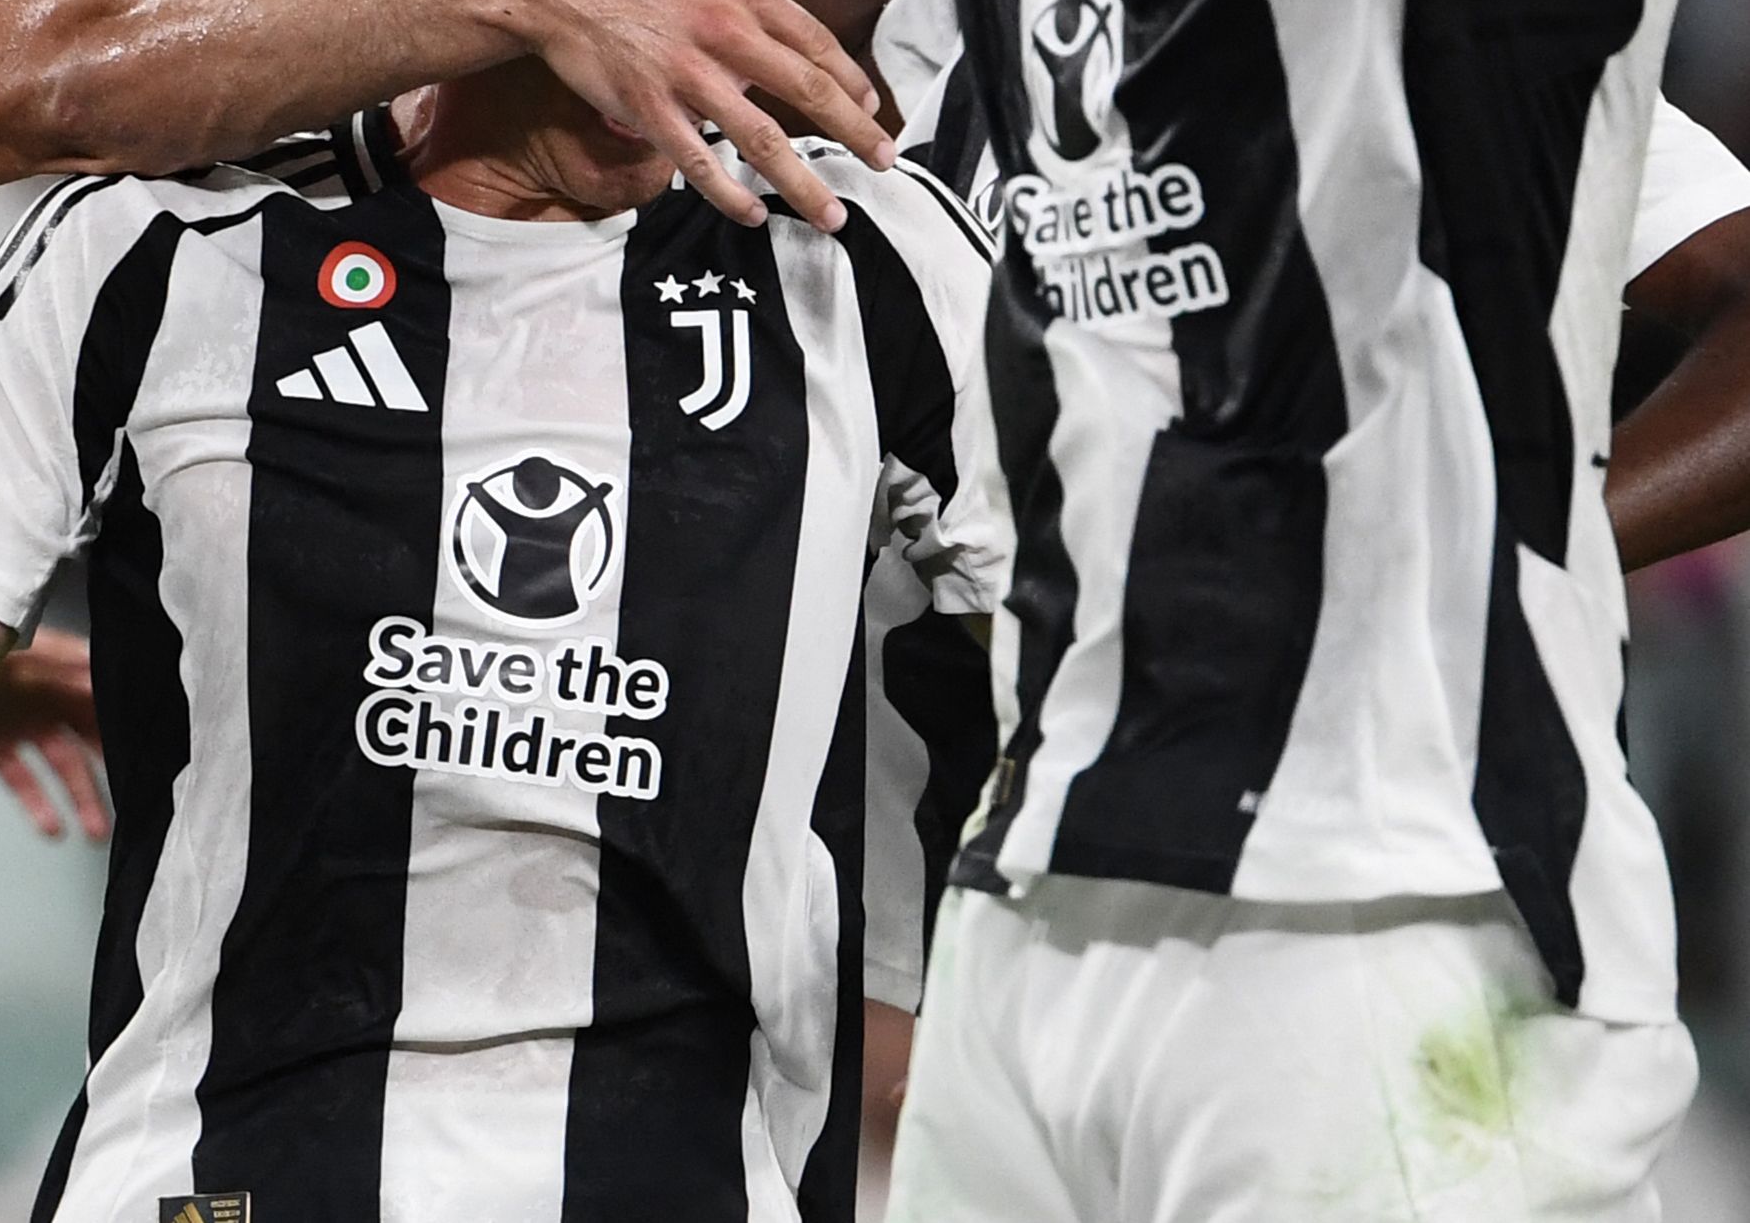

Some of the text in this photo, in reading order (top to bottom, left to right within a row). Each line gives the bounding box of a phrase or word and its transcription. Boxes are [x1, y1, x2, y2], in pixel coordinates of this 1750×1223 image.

[1102, 169, 1194, 233] the
[1037, 254, 1218, 323] hildren
[373, 623, 664, 711] Save the
[364, 696, 653, 792] Children
